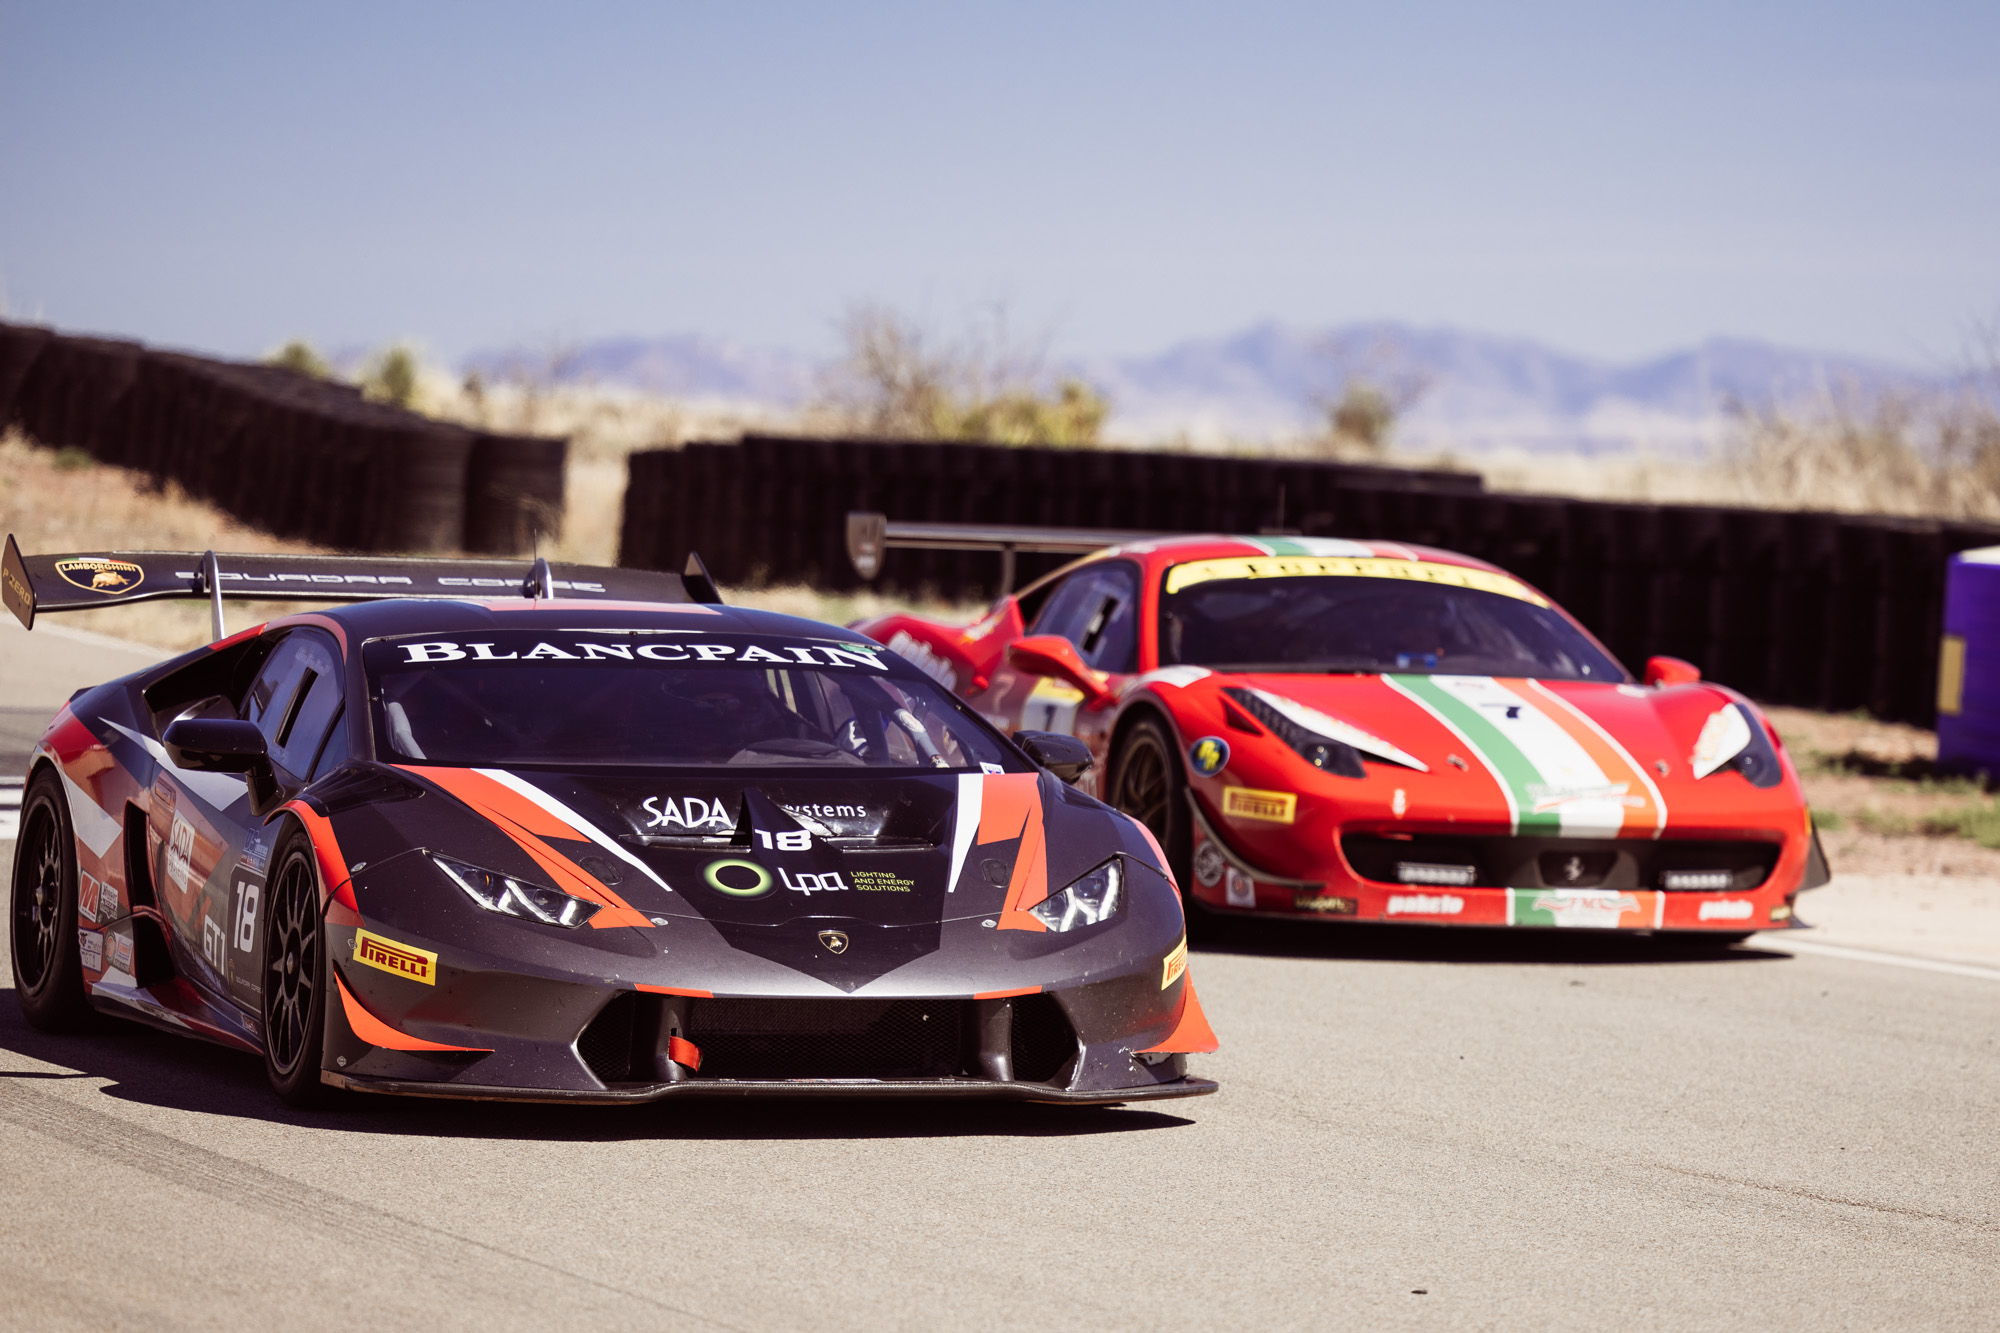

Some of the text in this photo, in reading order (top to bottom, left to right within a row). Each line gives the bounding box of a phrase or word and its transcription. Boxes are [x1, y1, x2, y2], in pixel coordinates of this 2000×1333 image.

[61, 562, 136, 572] LAMBORGHINI
[9, 576, 31, 605] ZERO
[397, 641, 889, 671] BLANCPAIN
[642, 796, 733, 828] SADA
[754, 828, 813, 851] 18
[850, 871, 896, 879] LIGHTING
[856, 885, 911, 893] SOLUTIONS
[877, 878, 915, 886] ENERGY
[234, 880, 260, 953] 18
[203, 913, 226, 976] GT1
[360, 936, 429, 978] PIRELLI
